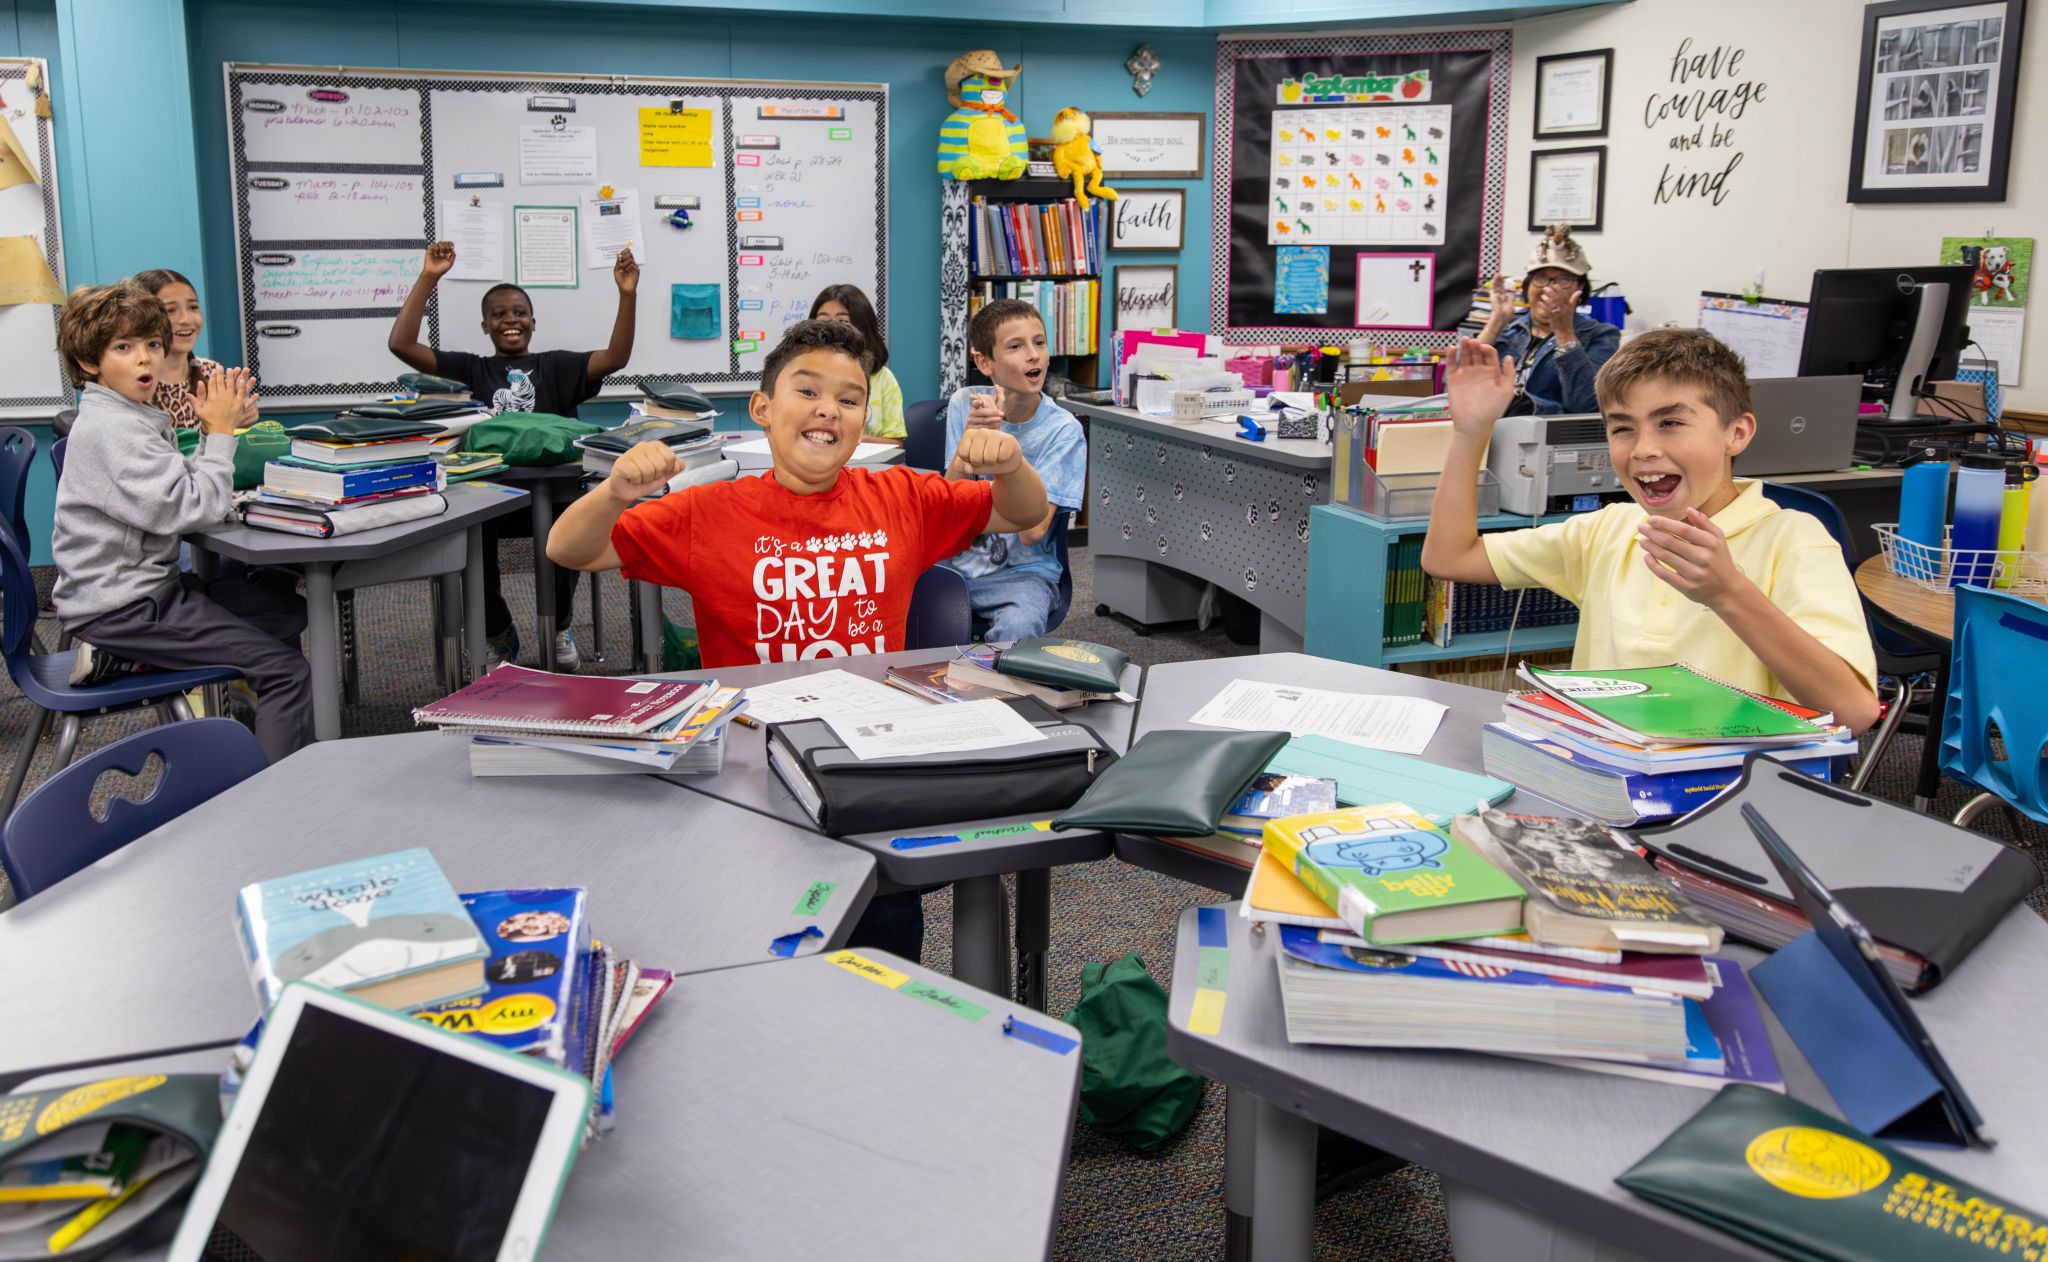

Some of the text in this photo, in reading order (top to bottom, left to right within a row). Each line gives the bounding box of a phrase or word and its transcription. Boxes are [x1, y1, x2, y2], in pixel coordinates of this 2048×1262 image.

[1670, 36, 1745, 84] have
[1302, 72, 1400, 100] September
[249, 102, 281, 110] MONDAY
[1107, 135, 1119, 145] He
[1120, 136, 1151, 145] restores
[1669, 122, 1735, 151] and be
[253, 180, 285, 188] TUESDAY
[1653, 152, 1744, 207] kind
[1115, 198, 1175, 240] faith
[1118, 282, 1176, 312] blessed
[754, 535, 804, 557] it's a
[752, 552, 890, 602] GREAT
[756, 597, 878, 641] DAY to
[848, 616, 883, 637] be a
[298, 876, 399, 904] whale
[1380, 873, 1457, 893] belly
[1412, 882, 1456, 898] up
[310, 888, 394, 912] done
[1617, 889, 1681, 915] Harry
[491, 1007, 536, 1022] my
